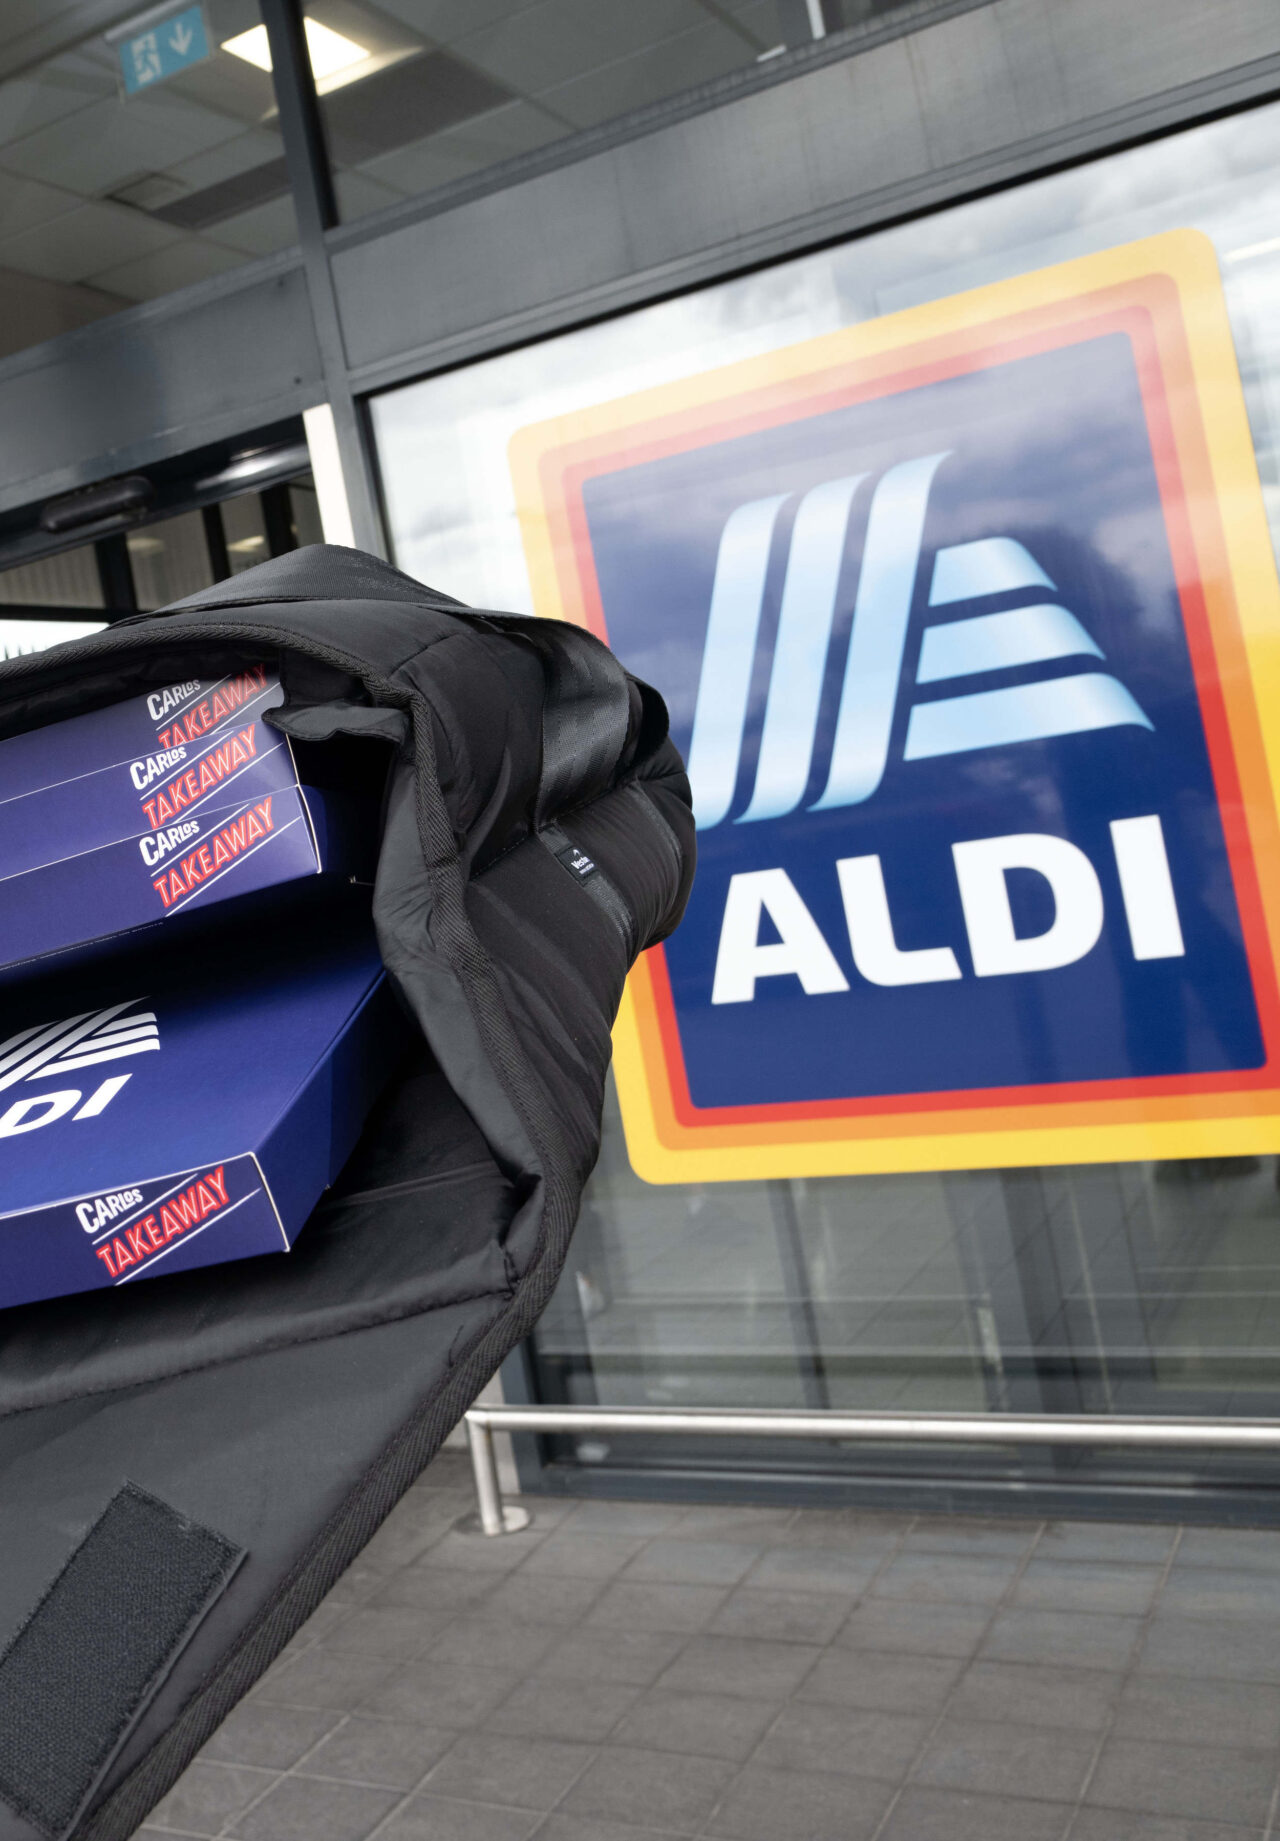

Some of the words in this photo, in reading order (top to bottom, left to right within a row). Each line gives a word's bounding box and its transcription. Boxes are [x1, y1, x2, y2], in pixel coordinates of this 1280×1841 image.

[158, 663, 268, 749] TAKEAWAY
[142, 723, 258, 830] TAKEAWAY
[153, 796, 275, 908] TAKEAWAY
[710, 814, 1186, 1006] ALDI
[95, 1165, 230, 1278] TAKEAWAY
